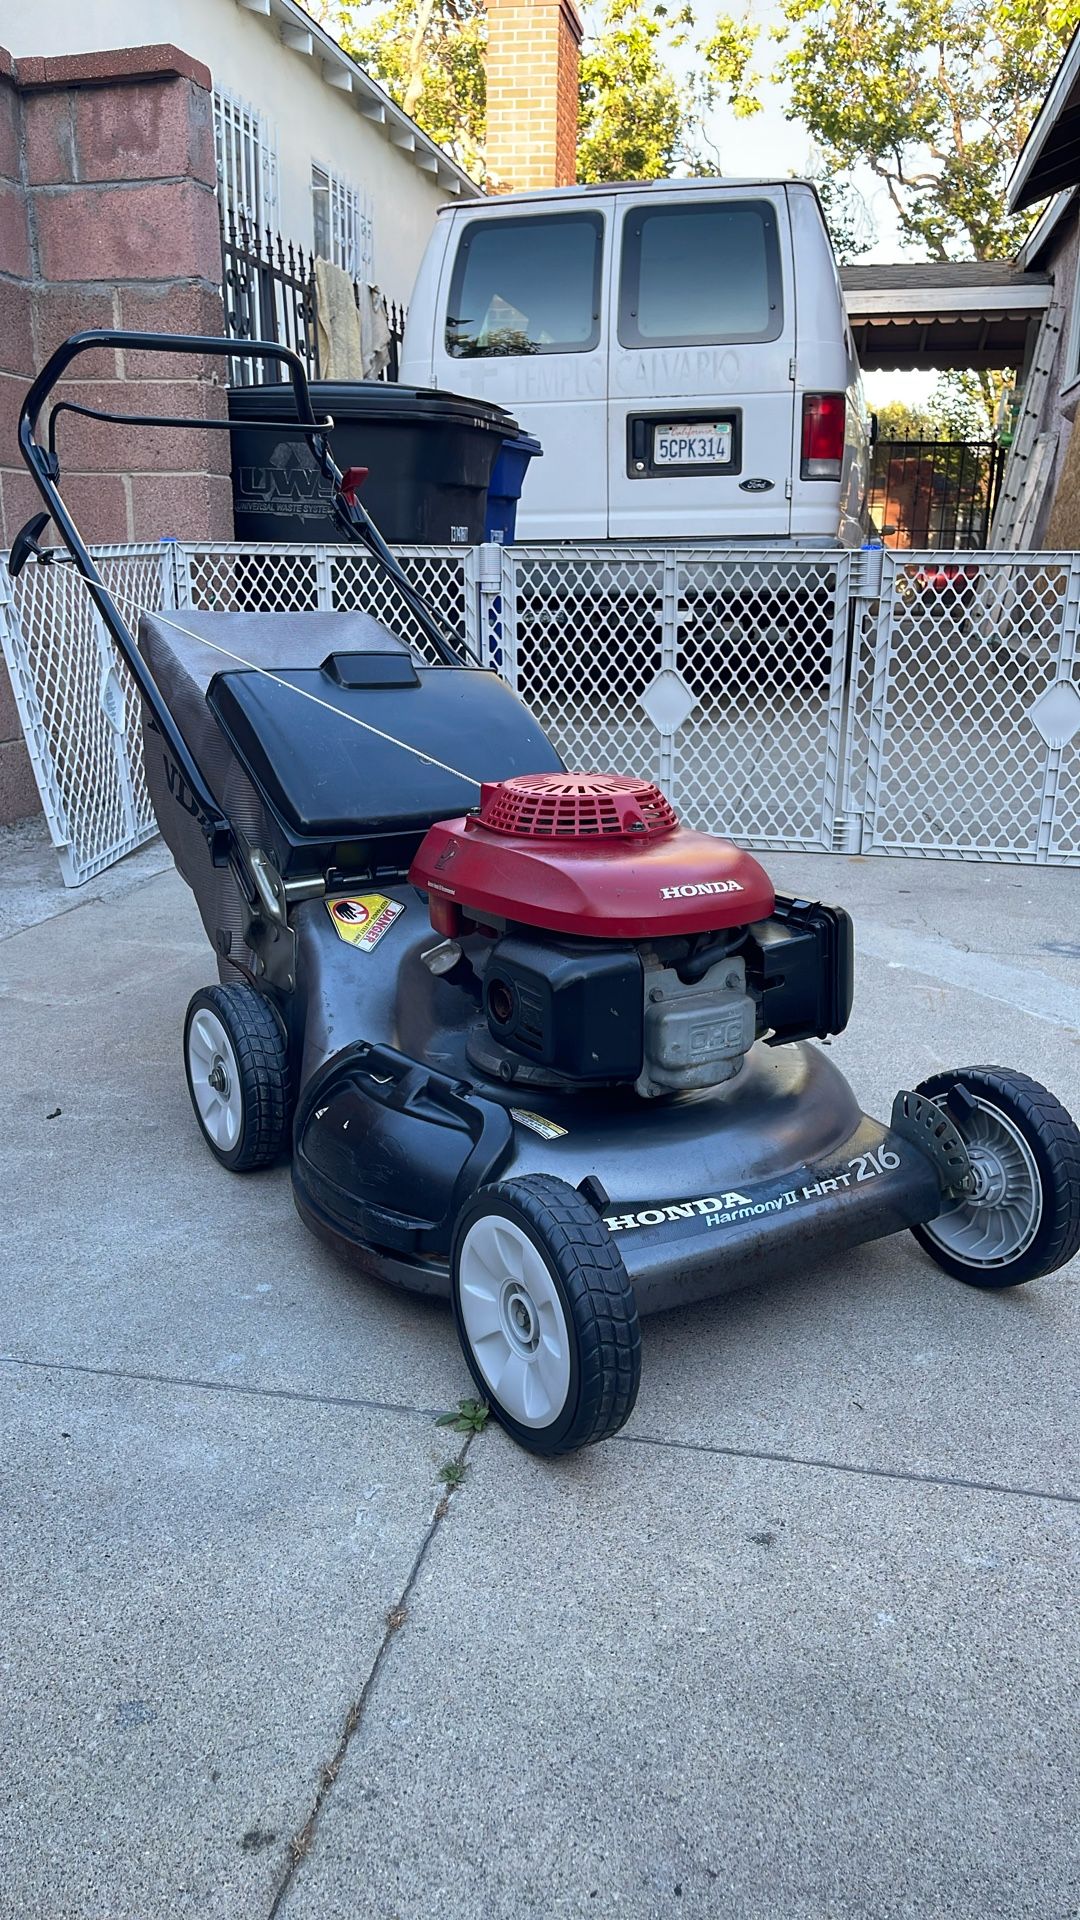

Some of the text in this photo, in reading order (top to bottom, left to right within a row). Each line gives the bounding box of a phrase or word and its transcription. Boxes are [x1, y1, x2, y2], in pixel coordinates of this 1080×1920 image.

[511, 348, 741, 397] TEMPLO CALVARIO
[659, 437, 726, 458] 5CPK314
[276, 503, 301, 513] WASTE
[660, 880, 744, 899] HONDA
[364, 909, 396, 943] DANGER
[690, 1022, 743, 1050] OHC
[705, 1198, 784, 1228] Harmony
[801, 1172, 852, 1200] HRT
[847, 1143, 902, 1183] 216
[602, 1191, 753, 1232] HONDA
